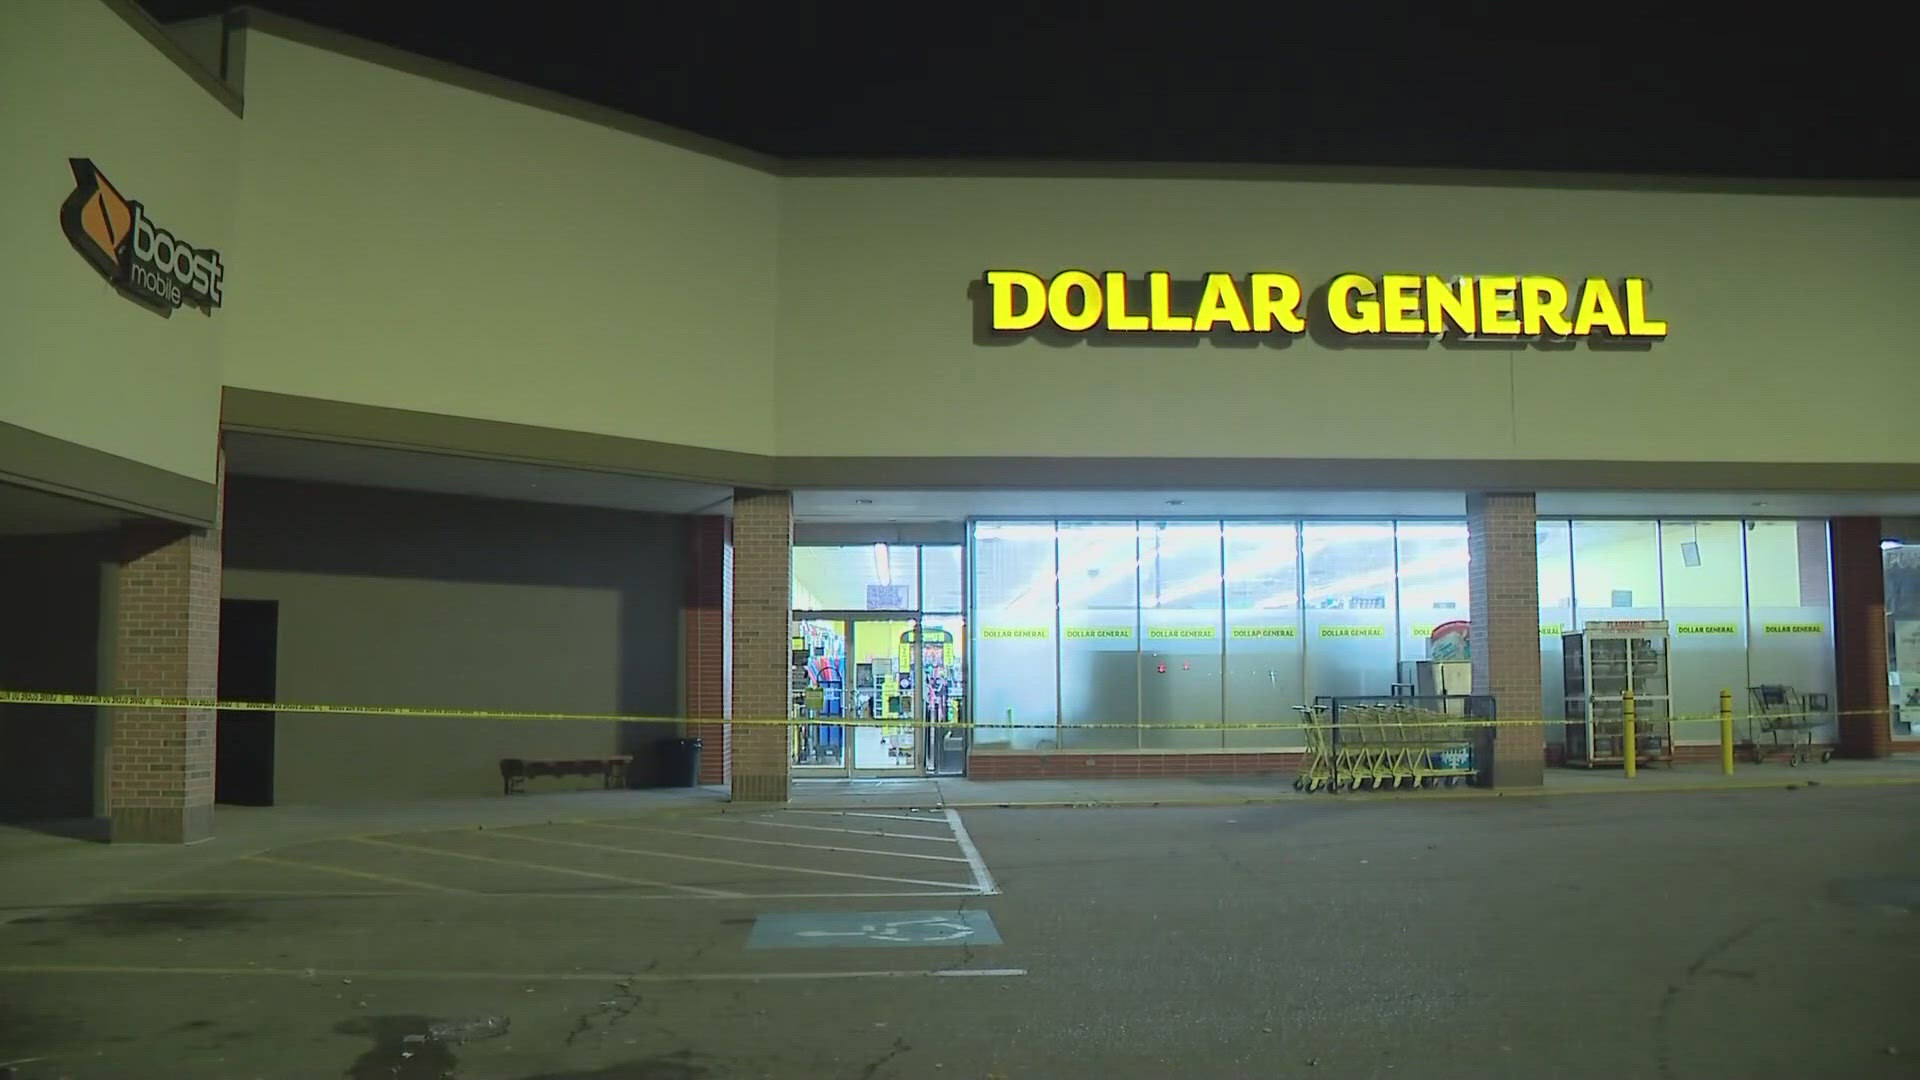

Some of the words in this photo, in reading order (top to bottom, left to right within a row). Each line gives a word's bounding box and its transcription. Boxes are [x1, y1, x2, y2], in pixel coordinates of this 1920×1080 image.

[133, 206, 221, 303] boost
[131, 264, 181, 304] mobile
[986, 271, 1306, 333] DOLLAR
[1327, 274, 1667, 337] GENERAL
[1262, 629, 1294, 637] GENERAL
[1321, 629, 1349, 637] DOLLAR
[1351, 629, 1382, 637] GENERAL
[1413, 628, 1430, 636] DOLL
[1678, 626, 1704, 634] DOLLAR
[1705, 625, 1734, 634] GENERAL
[1792, 625, 1821, 633] GENERAL
[983, 630, 1012, 638] DOLLAR
[1013, 630, 1047, 638] GENERAL
[1067, 630, 1095, 638] DOLLAR
[1097, 630, 1129, 638] GENERAL
[1150, 630, 1179, 638] DOLLAR
[1181, 630, 1212, 638] GENERAL
